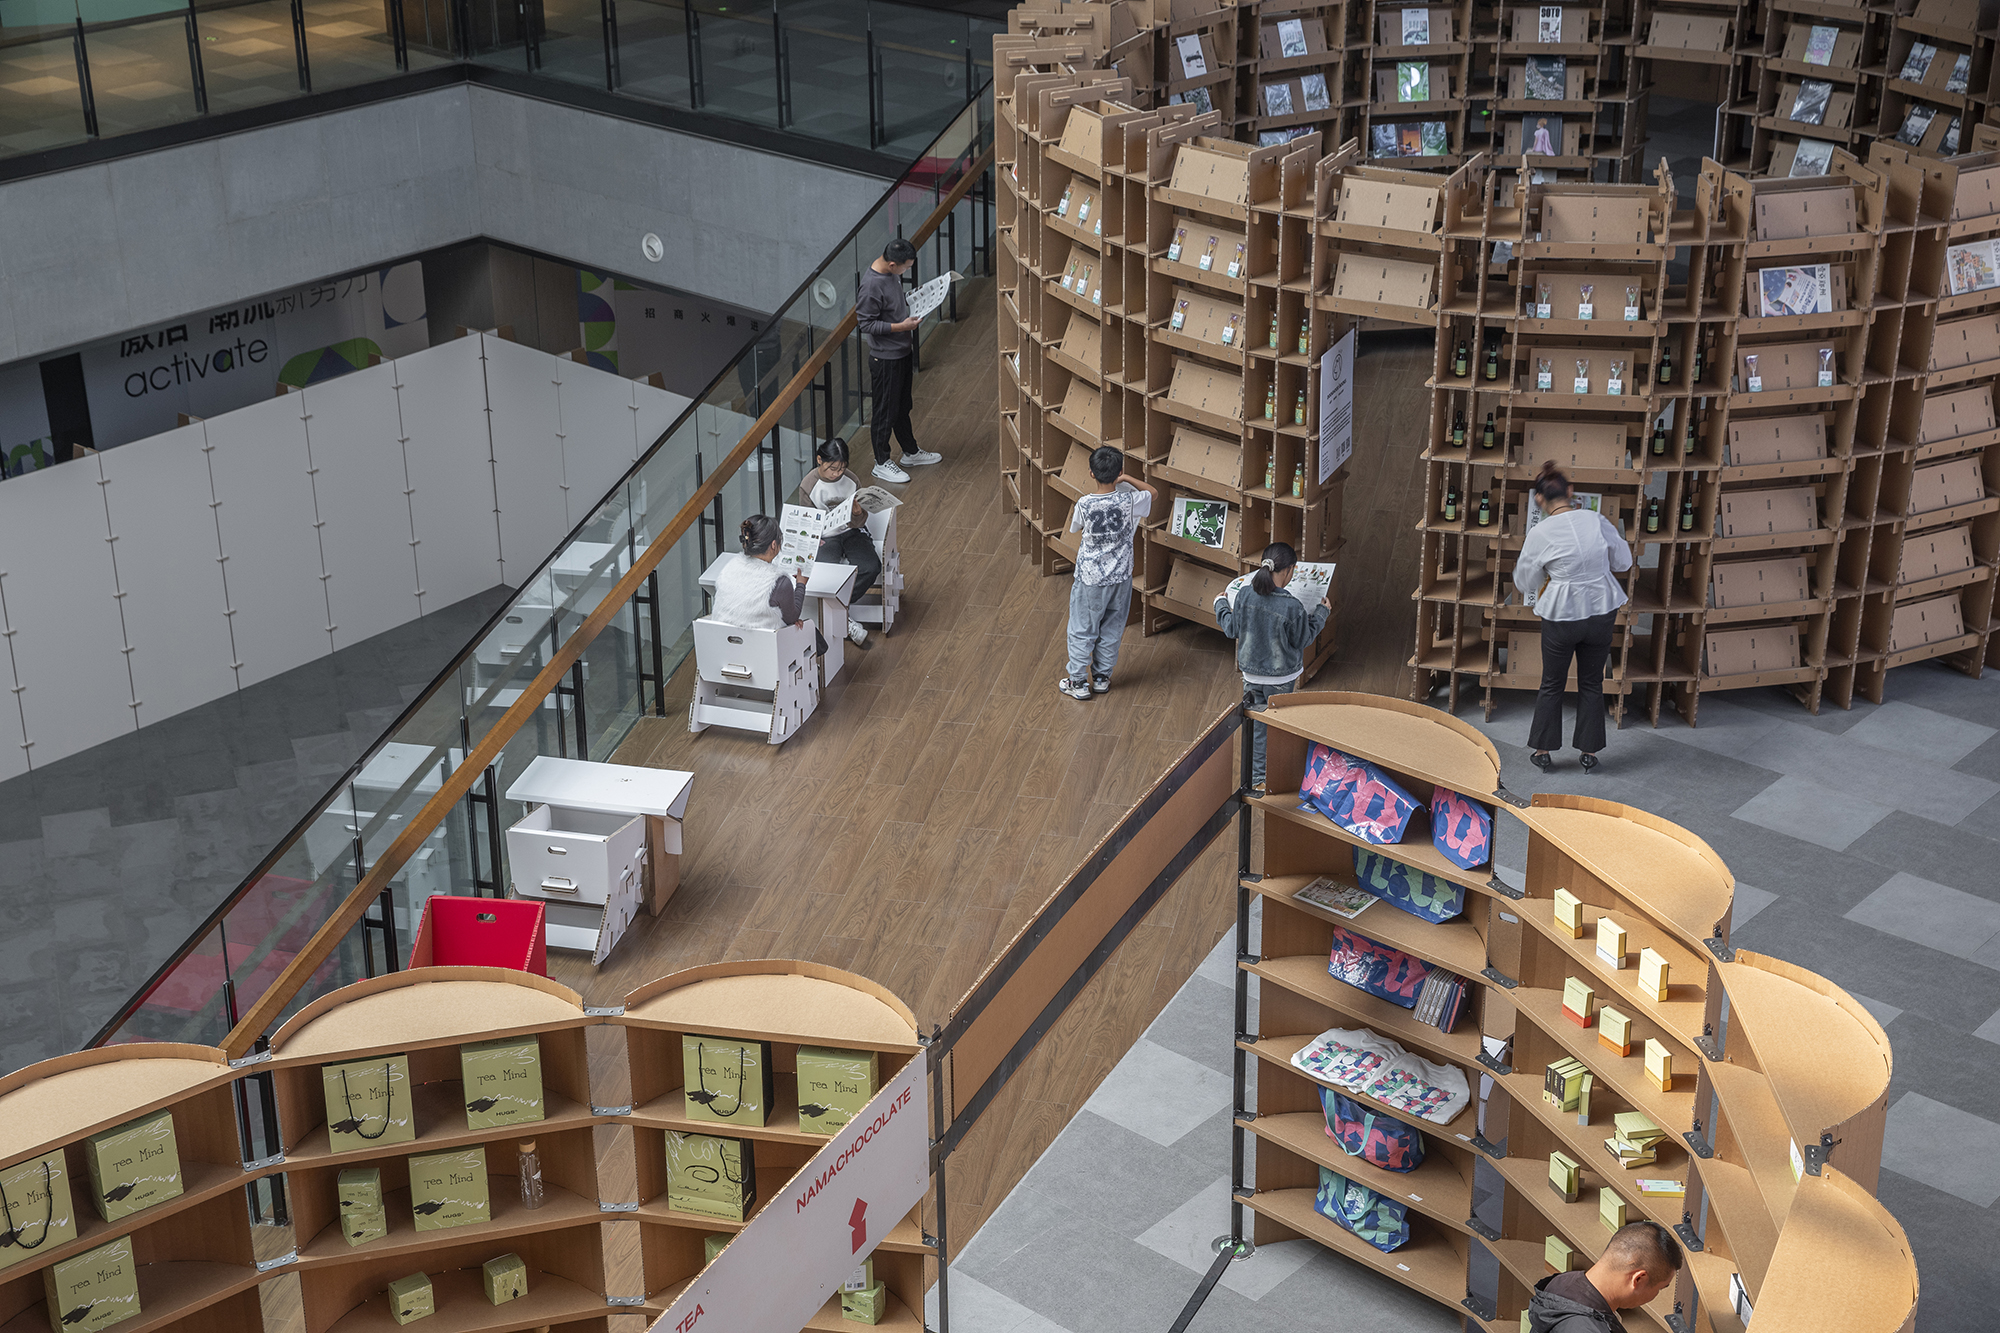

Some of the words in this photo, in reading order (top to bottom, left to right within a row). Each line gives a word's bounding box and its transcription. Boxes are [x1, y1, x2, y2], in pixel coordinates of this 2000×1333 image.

[124, 337, 268, 398] activate
[1089, 507, 1123, 534] 23
[477, 1074, 496, 1085] Tea
[503, 1069, 527, 1081] Mind
[723, 1067, 747, 1080] Mind
[369, 1087, 395, 1100] Mind
[810, 1081, 828, 1091] Tea
[834, 1081, 858, 1094] Mind
[112, 1157, 133, 1172] Tea
[139, 1144, 164, 1162] Mind
[796, 1086, 912, 1213] NAMACHOCOLATE
[424, 1177, 443, 1189] Tea
[449, 1172, 473, 1185] Mind
[26, 1186, 53, 1205] Mind
[69, 1280, 91, 1295] Tea
[96, 1265, 122, 1284] Mind
[675, 1303, 705, 1333] TEA
